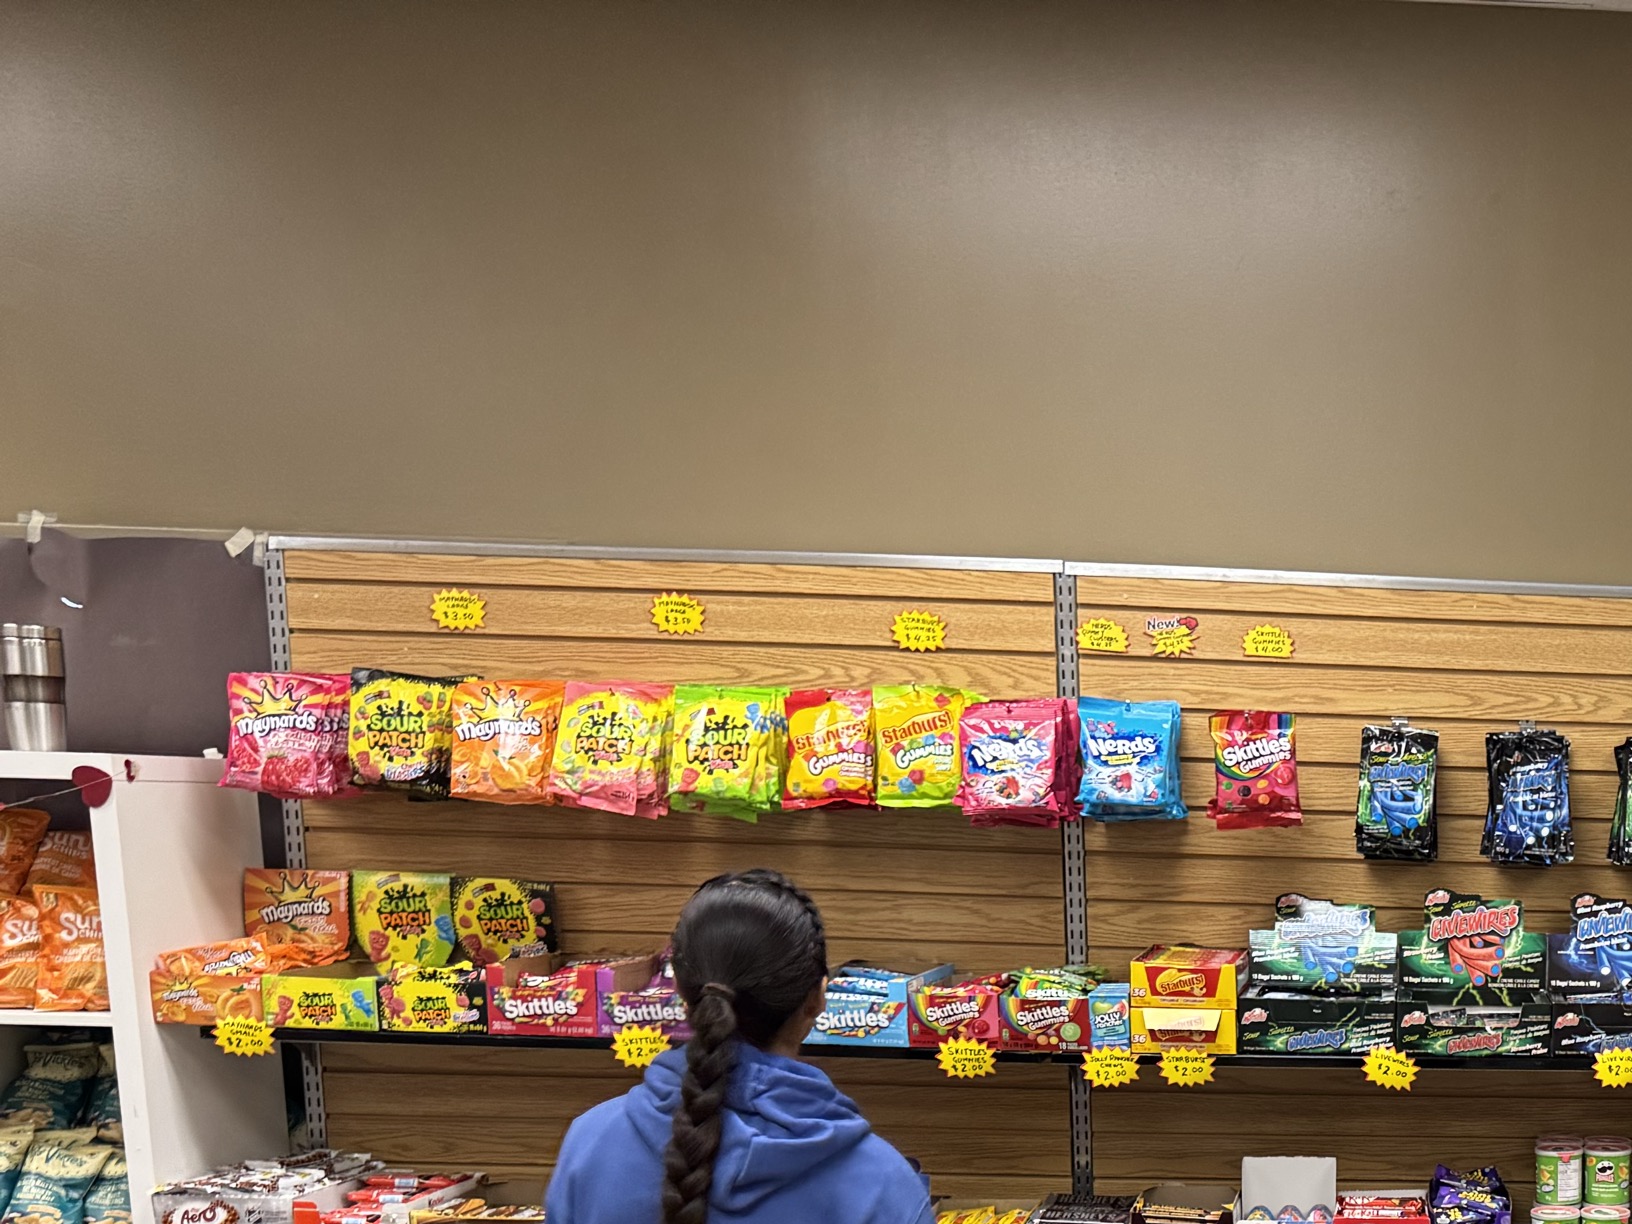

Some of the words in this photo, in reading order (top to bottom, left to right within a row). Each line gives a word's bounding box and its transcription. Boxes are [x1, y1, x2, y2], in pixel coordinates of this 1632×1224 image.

[236, 711, 318, 738] Maynards
[370, 713, 424, 733] SOUR
[580, 721, 634, 741] SOUR
[881, 710, 952, 747] Starburst
[367, 730, 426, 751] PATCH
[575, 737, 633, 755] PATCH
[1222, 735, 1293, 763] Skittles
[1239, 751, 1292, 774] Gummies
[1131, 988, 1146, 998] 36
[504, 996, 579, 1020] Skittles
[947, 1047, 987, 1056] SKITTLES
[952, 1063, 984, 1073] $2.00
[1096, 1070, 1127, 1081] $2.00
[1174, 1065, 1205, 1077] $2.00
[1378, 1063, 1408, 1078] $2.00
